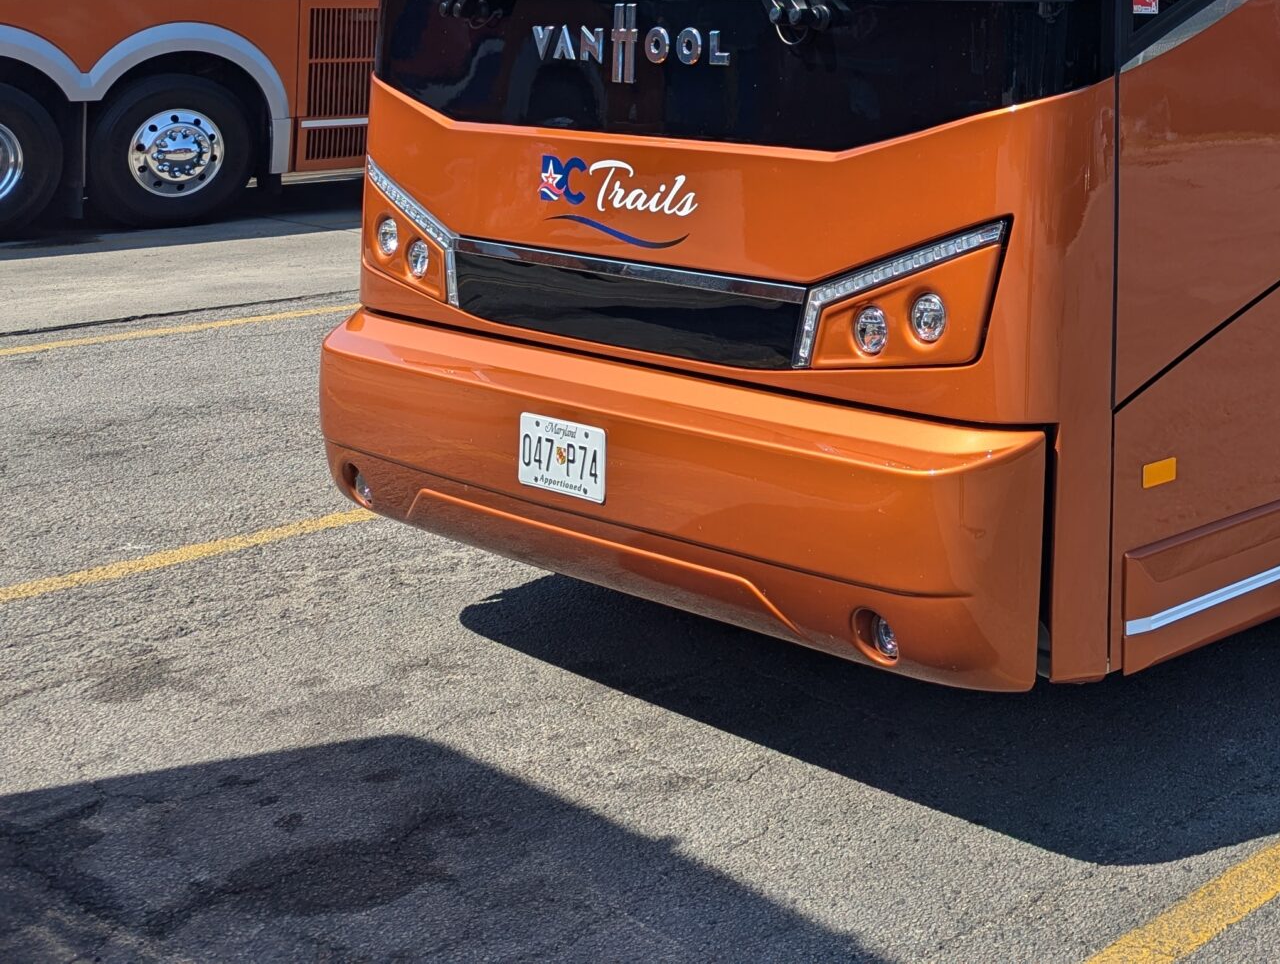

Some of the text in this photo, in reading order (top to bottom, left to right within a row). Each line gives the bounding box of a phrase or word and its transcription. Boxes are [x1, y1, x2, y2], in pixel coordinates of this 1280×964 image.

[589, 159, 699, 217] Trails
[545, 421, 578, 440] Maryland
[523, 433, 598, 485] 047 P74
[540, 474, 583, 492] Apportioned
